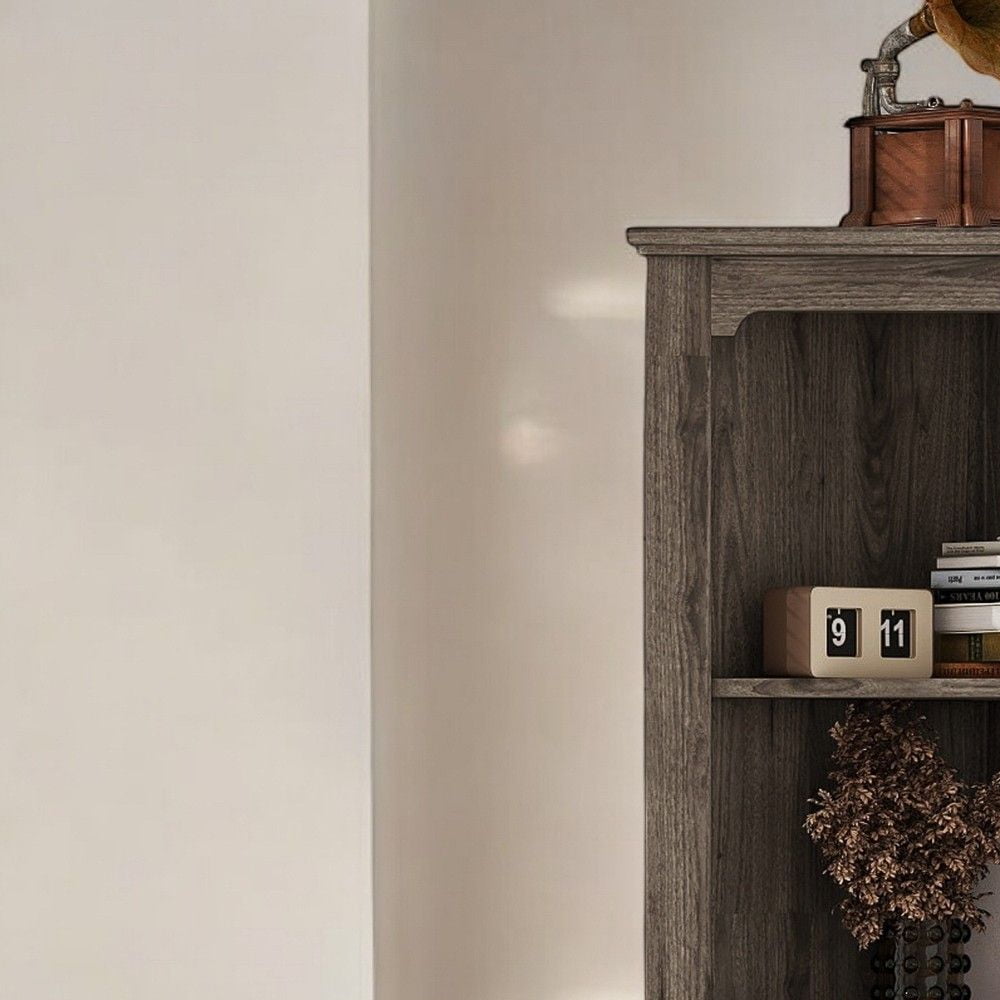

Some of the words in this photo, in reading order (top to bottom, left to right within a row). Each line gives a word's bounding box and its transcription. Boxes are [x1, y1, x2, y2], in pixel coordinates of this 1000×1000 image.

[949, 592, 981, 601] YEARS
[831, 617, 847, 647] 9
[880, 618, 905, 647] 11
